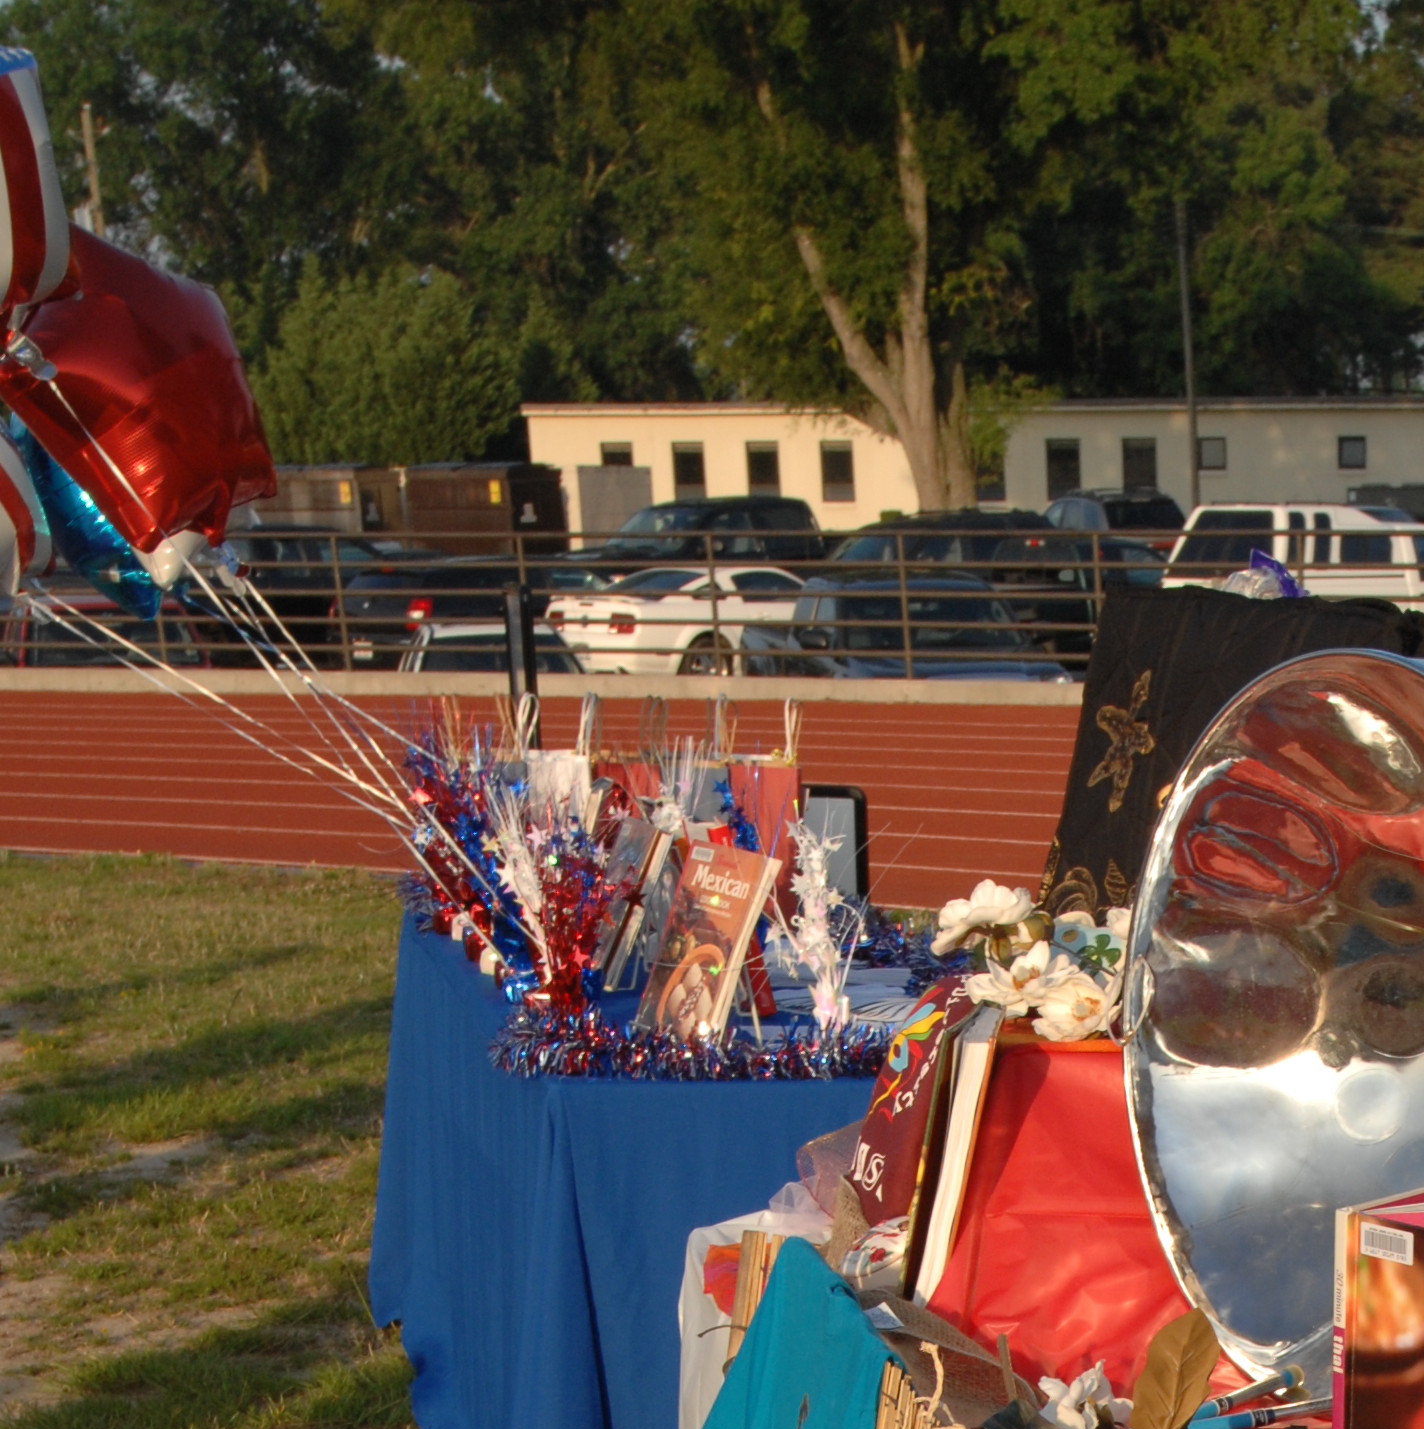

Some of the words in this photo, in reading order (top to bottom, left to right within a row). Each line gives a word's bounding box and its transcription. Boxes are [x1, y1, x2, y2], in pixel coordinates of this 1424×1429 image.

[691, 864, 750, 899] Mexican
[1335, 1287, 1344, 1323] minute
[1333, 1335, 1345, 1374] thai
